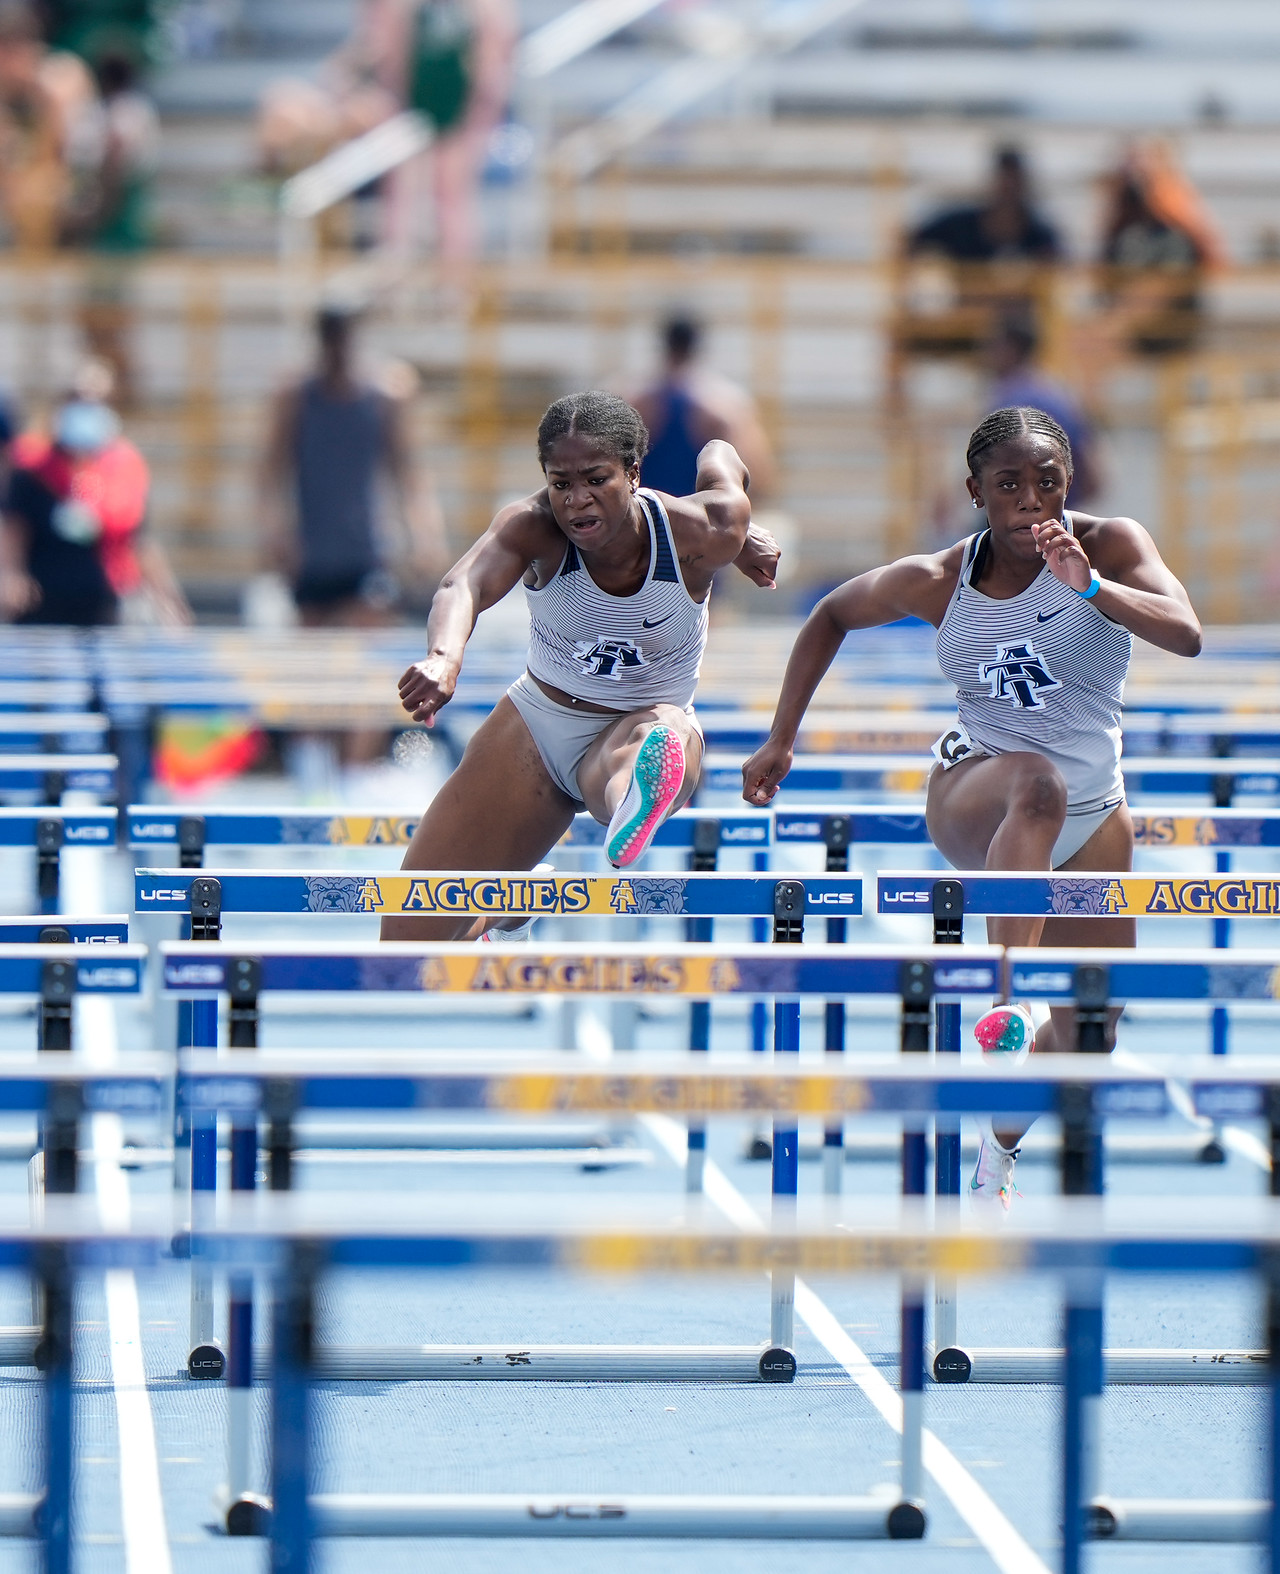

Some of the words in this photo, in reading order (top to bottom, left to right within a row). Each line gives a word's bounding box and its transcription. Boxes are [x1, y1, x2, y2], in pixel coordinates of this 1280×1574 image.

[66, 826, 109, 839] UCS
[132, 824, 176, 837] UCS
[722, 827, 765, 840] UCS
[778, 822, 821, 836] UCS
[140, 889, 187, 900] UCS
[402, 878, 589, 913] AGGIES
[808, 893, 854, 904] UCS
[884, 891, 930, 903] UCS
[1145, 880, 1280, 914] AGGI
[77, 966, 136, 986] UCS
[166, 964, 224, 984] UCS
[472, 956, 686, 992] AGGIES
[934, 967, 994, 987] UCS
[192, 1359, 222, 1369] UCS
[763, 1362, 793, 1371] UCS
[938, 1362, 967, 1371] UCS
[528, 1502, 626, 1519] UCS
